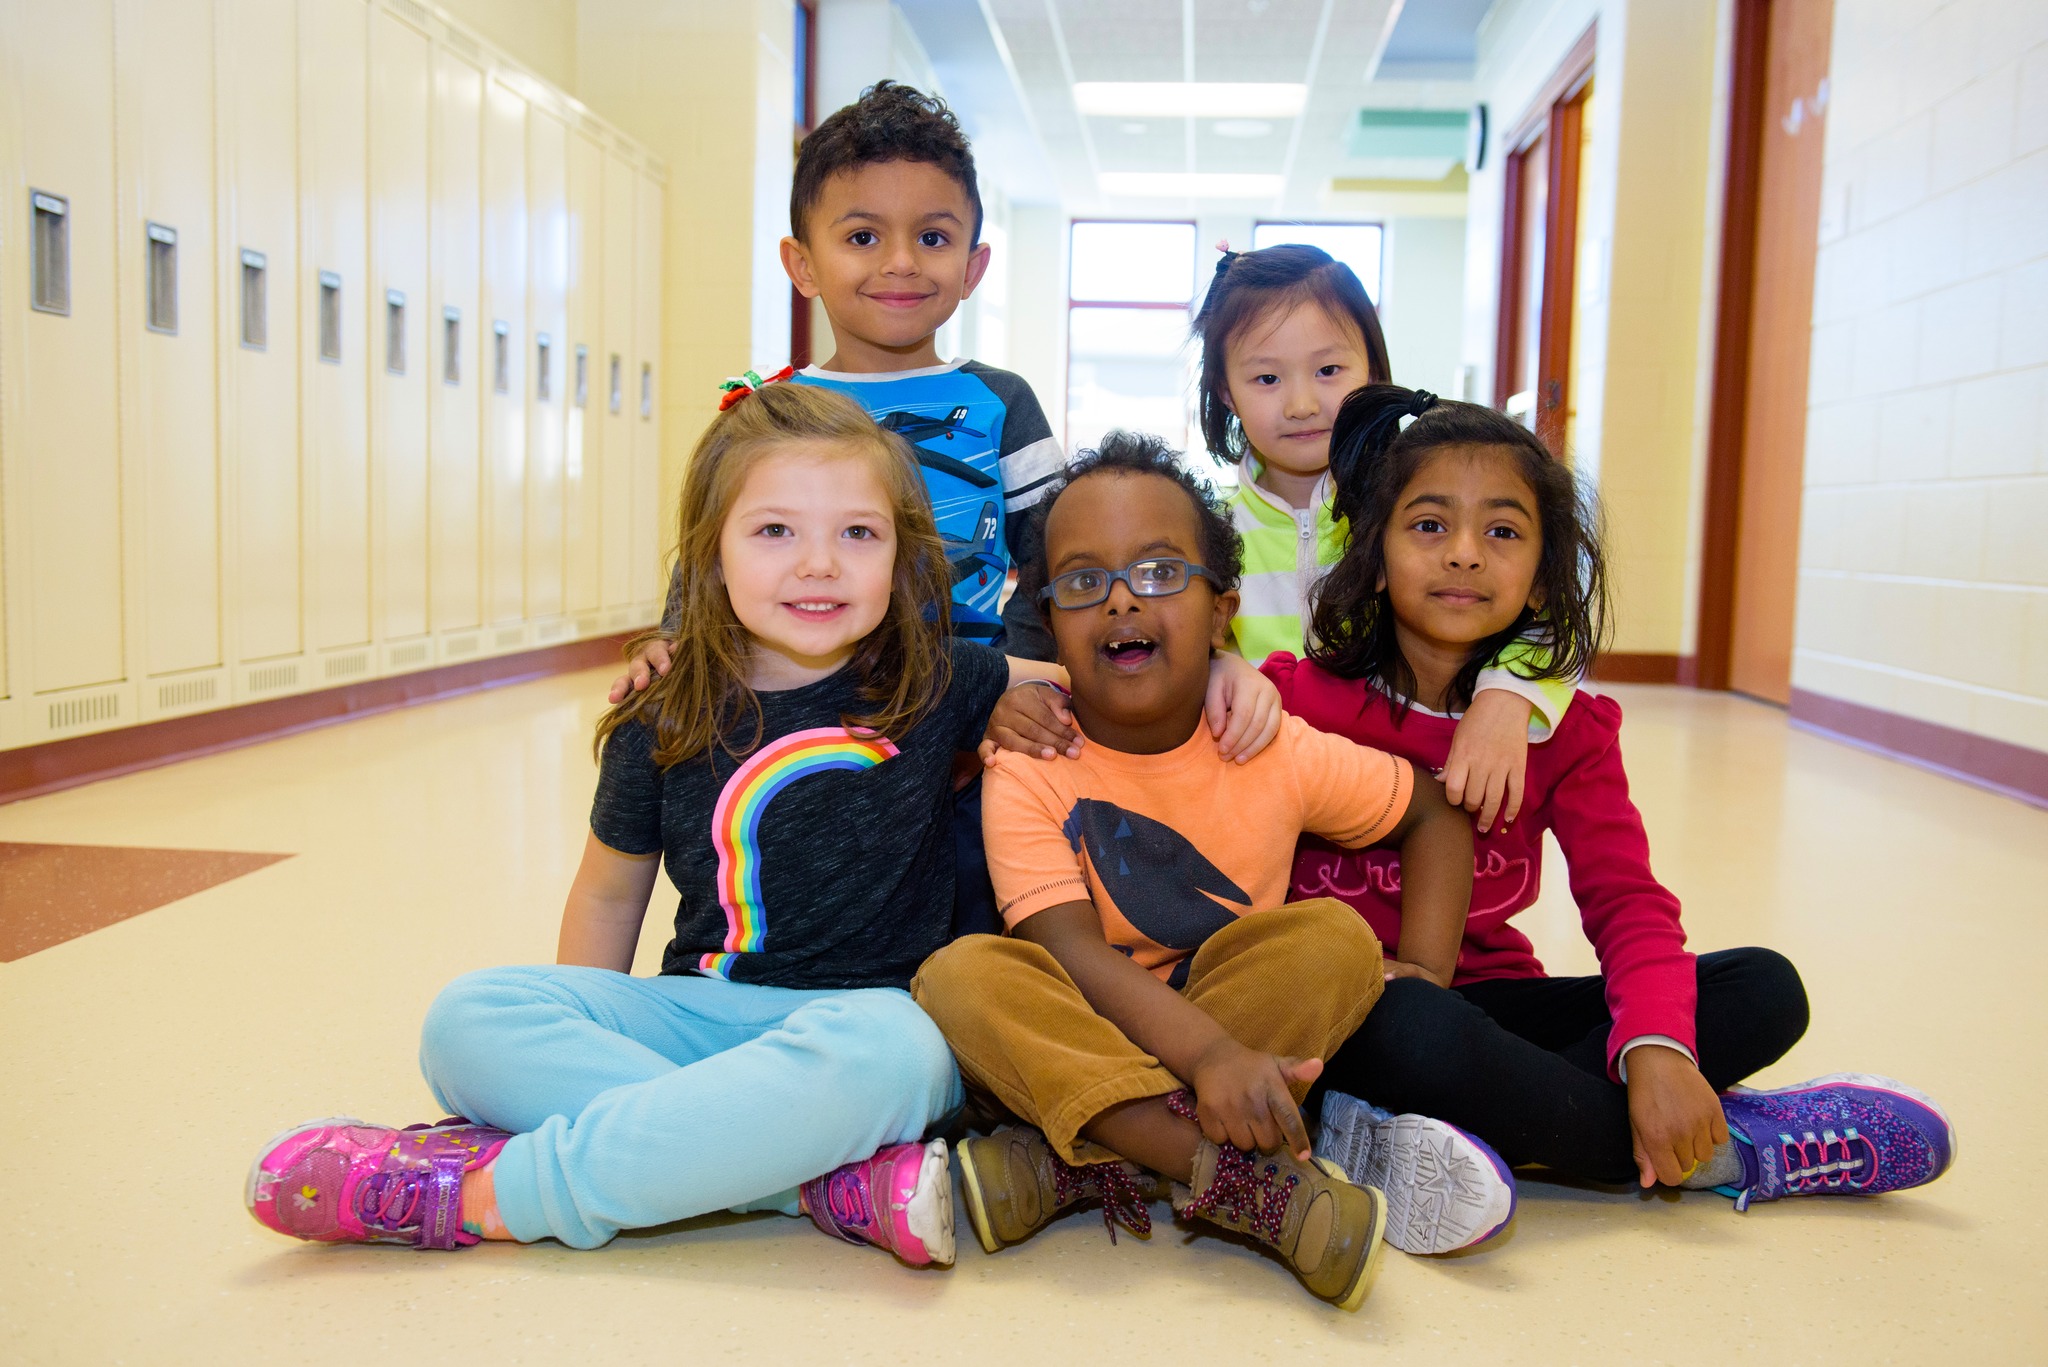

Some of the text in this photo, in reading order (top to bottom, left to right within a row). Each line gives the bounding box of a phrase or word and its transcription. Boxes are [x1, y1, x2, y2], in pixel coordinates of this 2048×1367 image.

[953, 408, 967, 419] 19
[982, 517, 997, 540] 72
[1760, 1144, 1780, 1198] Lights
[440, 1184, 449, 1207] PAW
